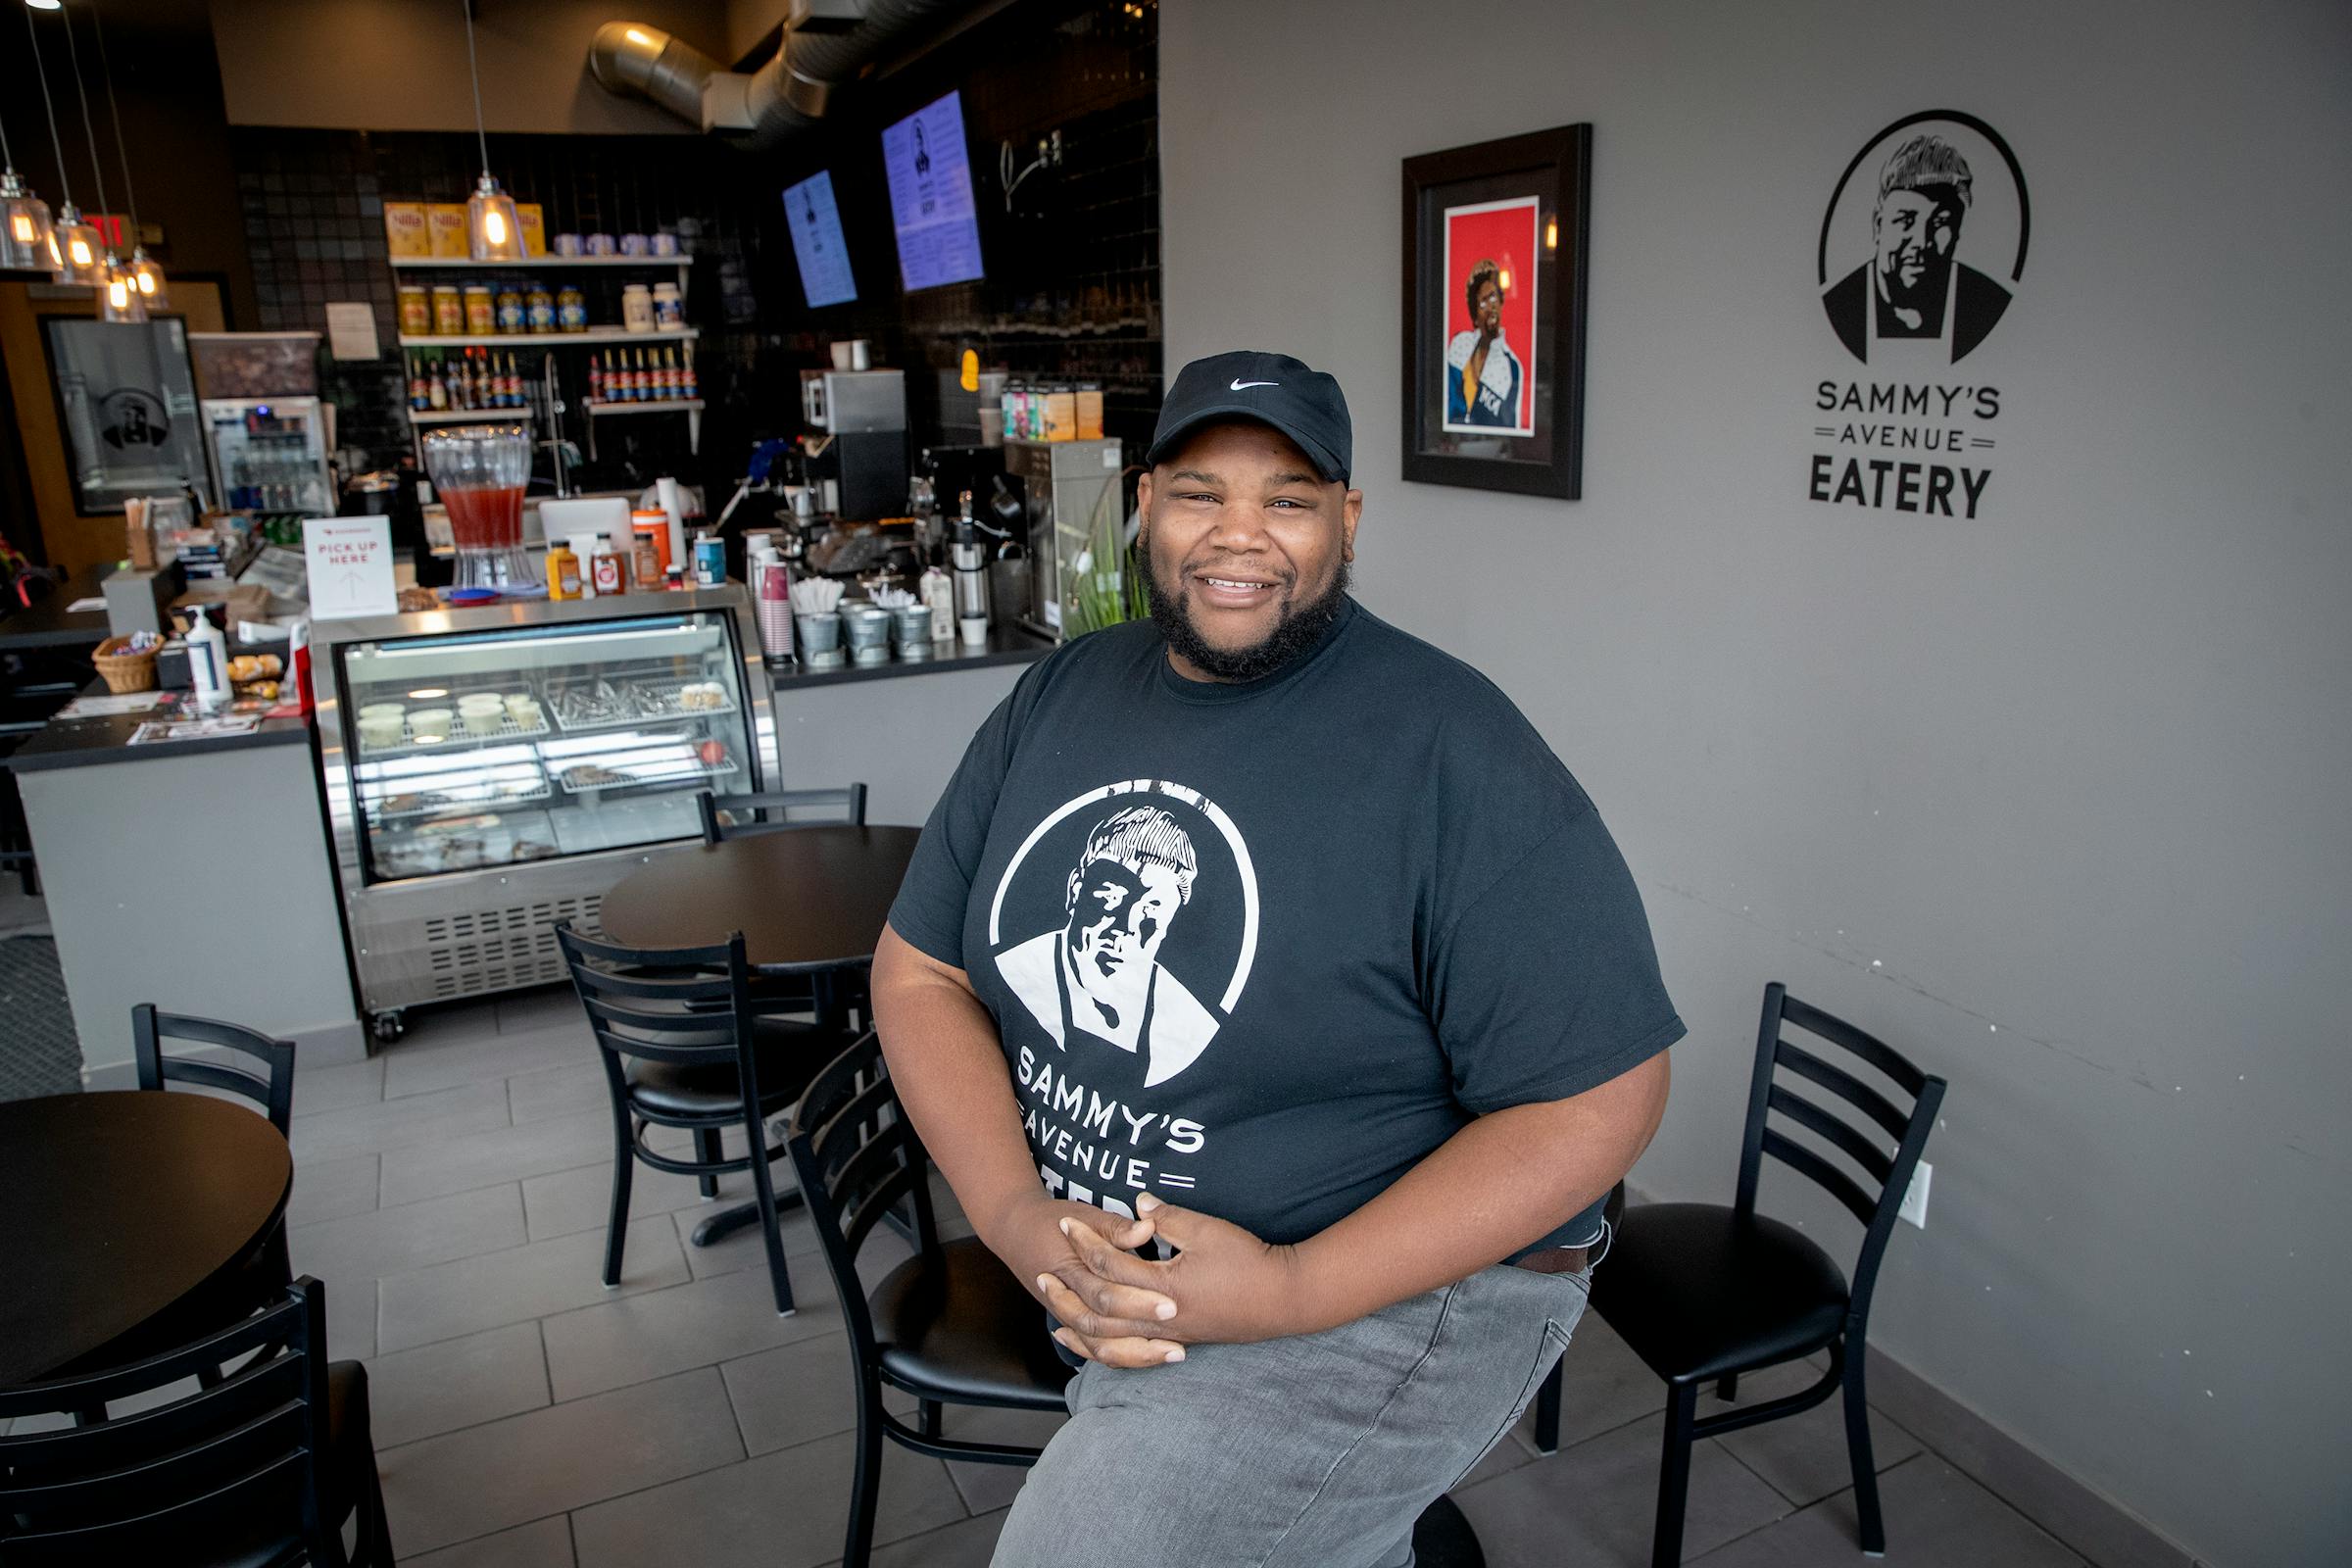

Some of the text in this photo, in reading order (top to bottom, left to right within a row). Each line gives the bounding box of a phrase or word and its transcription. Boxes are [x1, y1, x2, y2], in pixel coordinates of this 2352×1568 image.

[1816, 380, 2000, 419] SAMMY'S
[1840, 423, 1964, 452] AVENUE
[1809, 454, 1992, 519] EATERY
[318, 541, 377, 554] PICK UP
[329, 554, 368, 564] HERE
[1017, 1045, 1205, 1153] SAMMY'S
[1024, 1108, 1151, 1190] AVENUE
